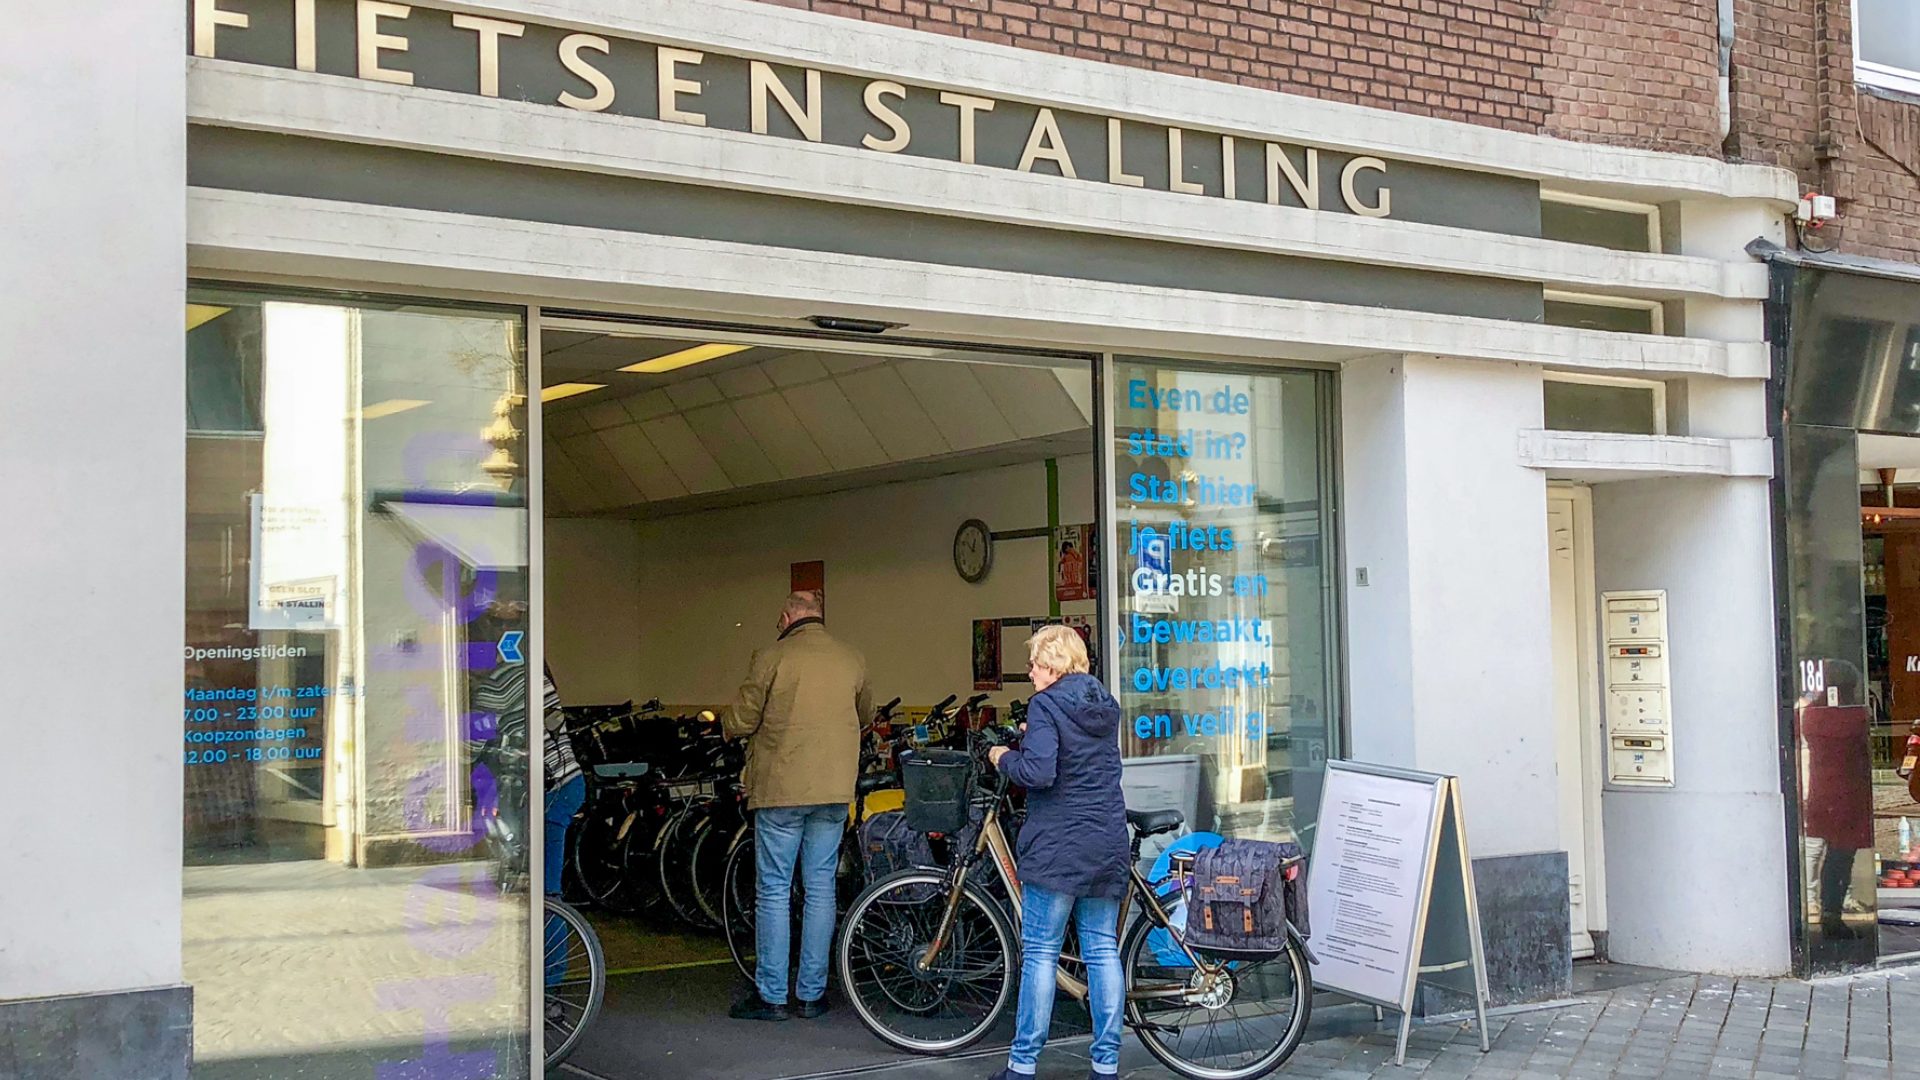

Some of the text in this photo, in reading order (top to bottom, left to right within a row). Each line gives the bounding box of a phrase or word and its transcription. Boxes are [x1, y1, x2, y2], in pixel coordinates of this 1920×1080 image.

[193, 0, 1391, 217] FIETSENSTALLING
[1128, 379, 1249, 415] Even de
[1128, 428, 1246, 460] stad in?
[1129, 472, 1257, 507] Stal hier
[1131, 567, 1269, 598] Gratis en
[1132, 613, 1271, 647] bewaakt,
[184, 645, 306, 661] Openingstijden
[1133, 659, 1272, 692] overdekt
[1800, 659, 1824, 691] 18d
[184, 686, 257, 702] Maandag
[262, 685, 291, 700] t/m
[184, 708, 218, 722] 7.00
[236, 706, 284, 720] 23.00
[289, 706, 317, 719] uur
[1135, 704, 1274, 741] en veilg.
[184, 726, 306, 744] Koopzondagen
[245, 747, 290, 761] 18.00
[295, 747, 321, 759] uur
[370, 429, 497, 1080] Heerlen
